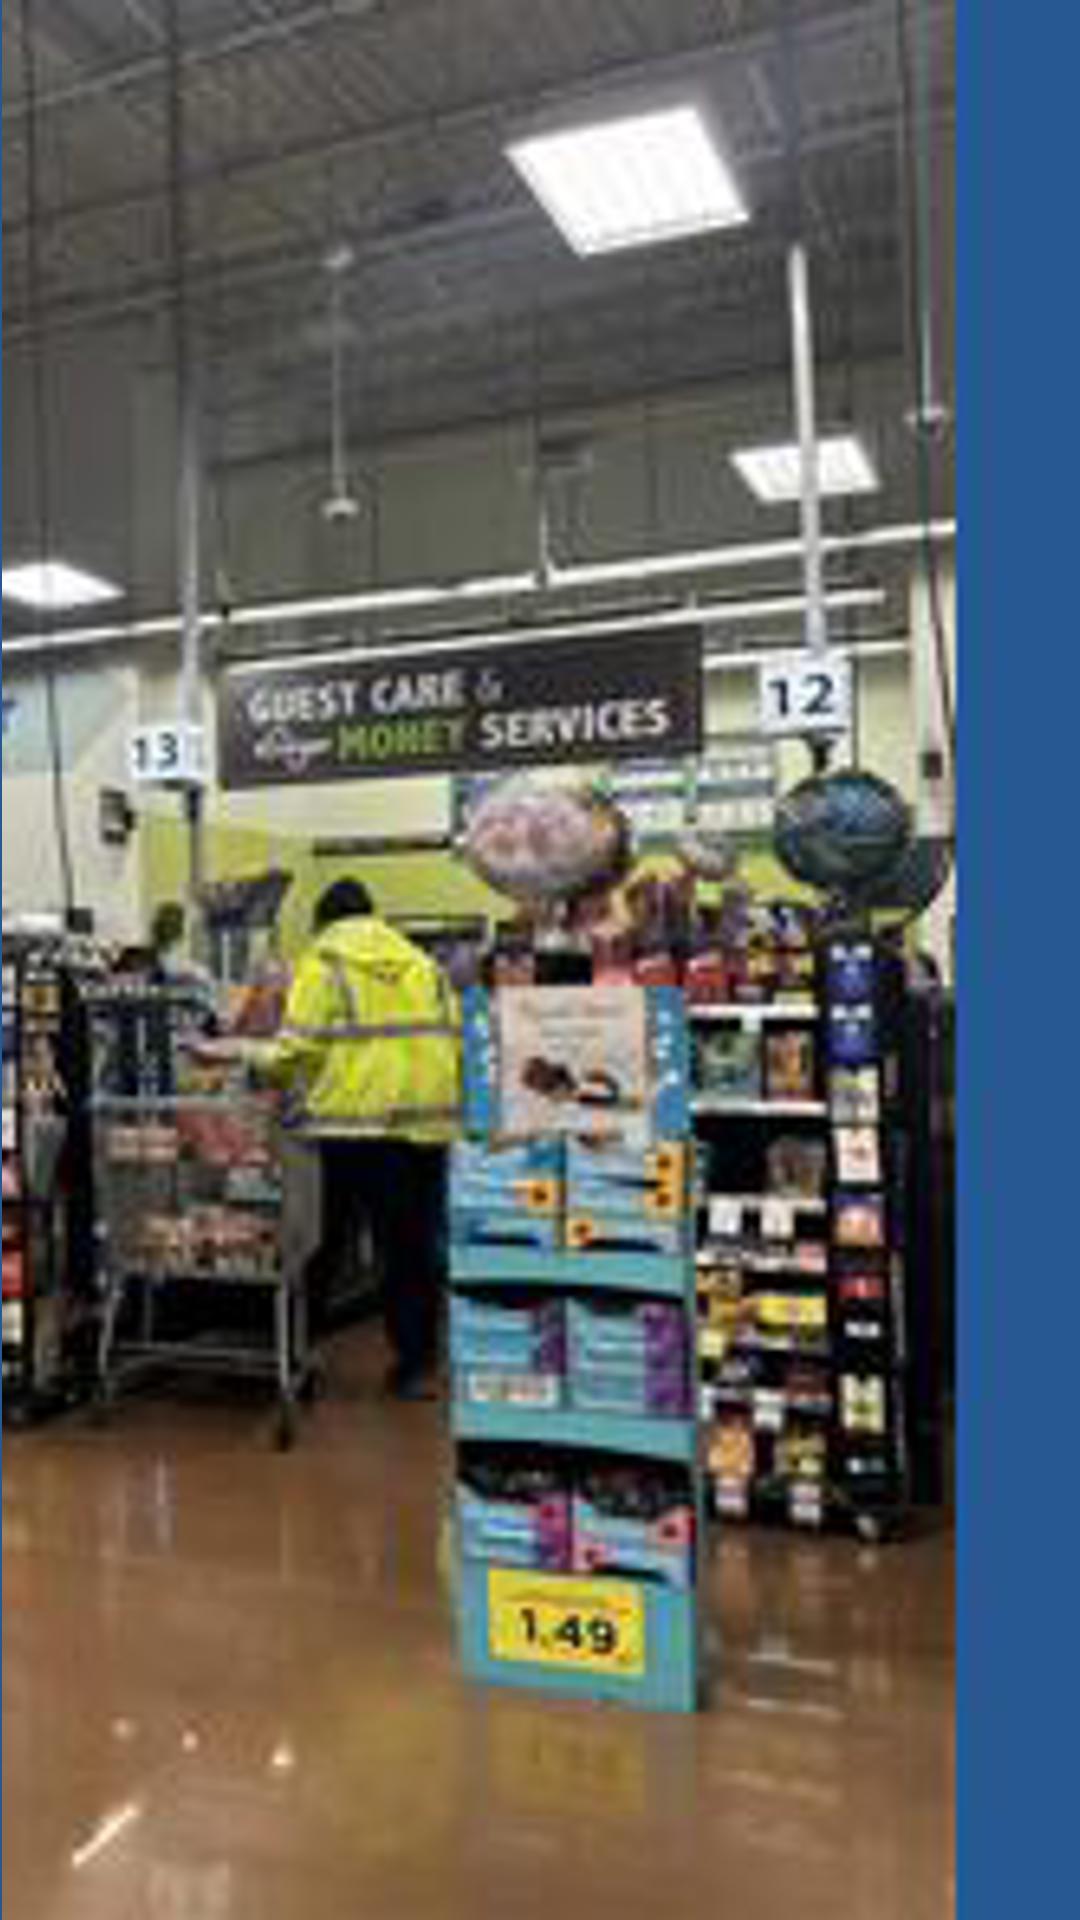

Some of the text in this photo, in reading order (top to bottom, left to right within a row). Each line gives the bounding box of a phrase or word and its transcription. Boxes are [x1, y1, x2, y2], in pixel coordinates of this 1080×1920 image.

[248, 679, 359, 725] GUEST
[370, 667, 468, 714] CARE
[766, 673, 836, 718] 12
[132, 730, 179, 772] 13
[338, 715, 466, 761] MONEY
[480, 699, 671, 749] SERVICES
[520, 1607, 618, 1656] 1.49
